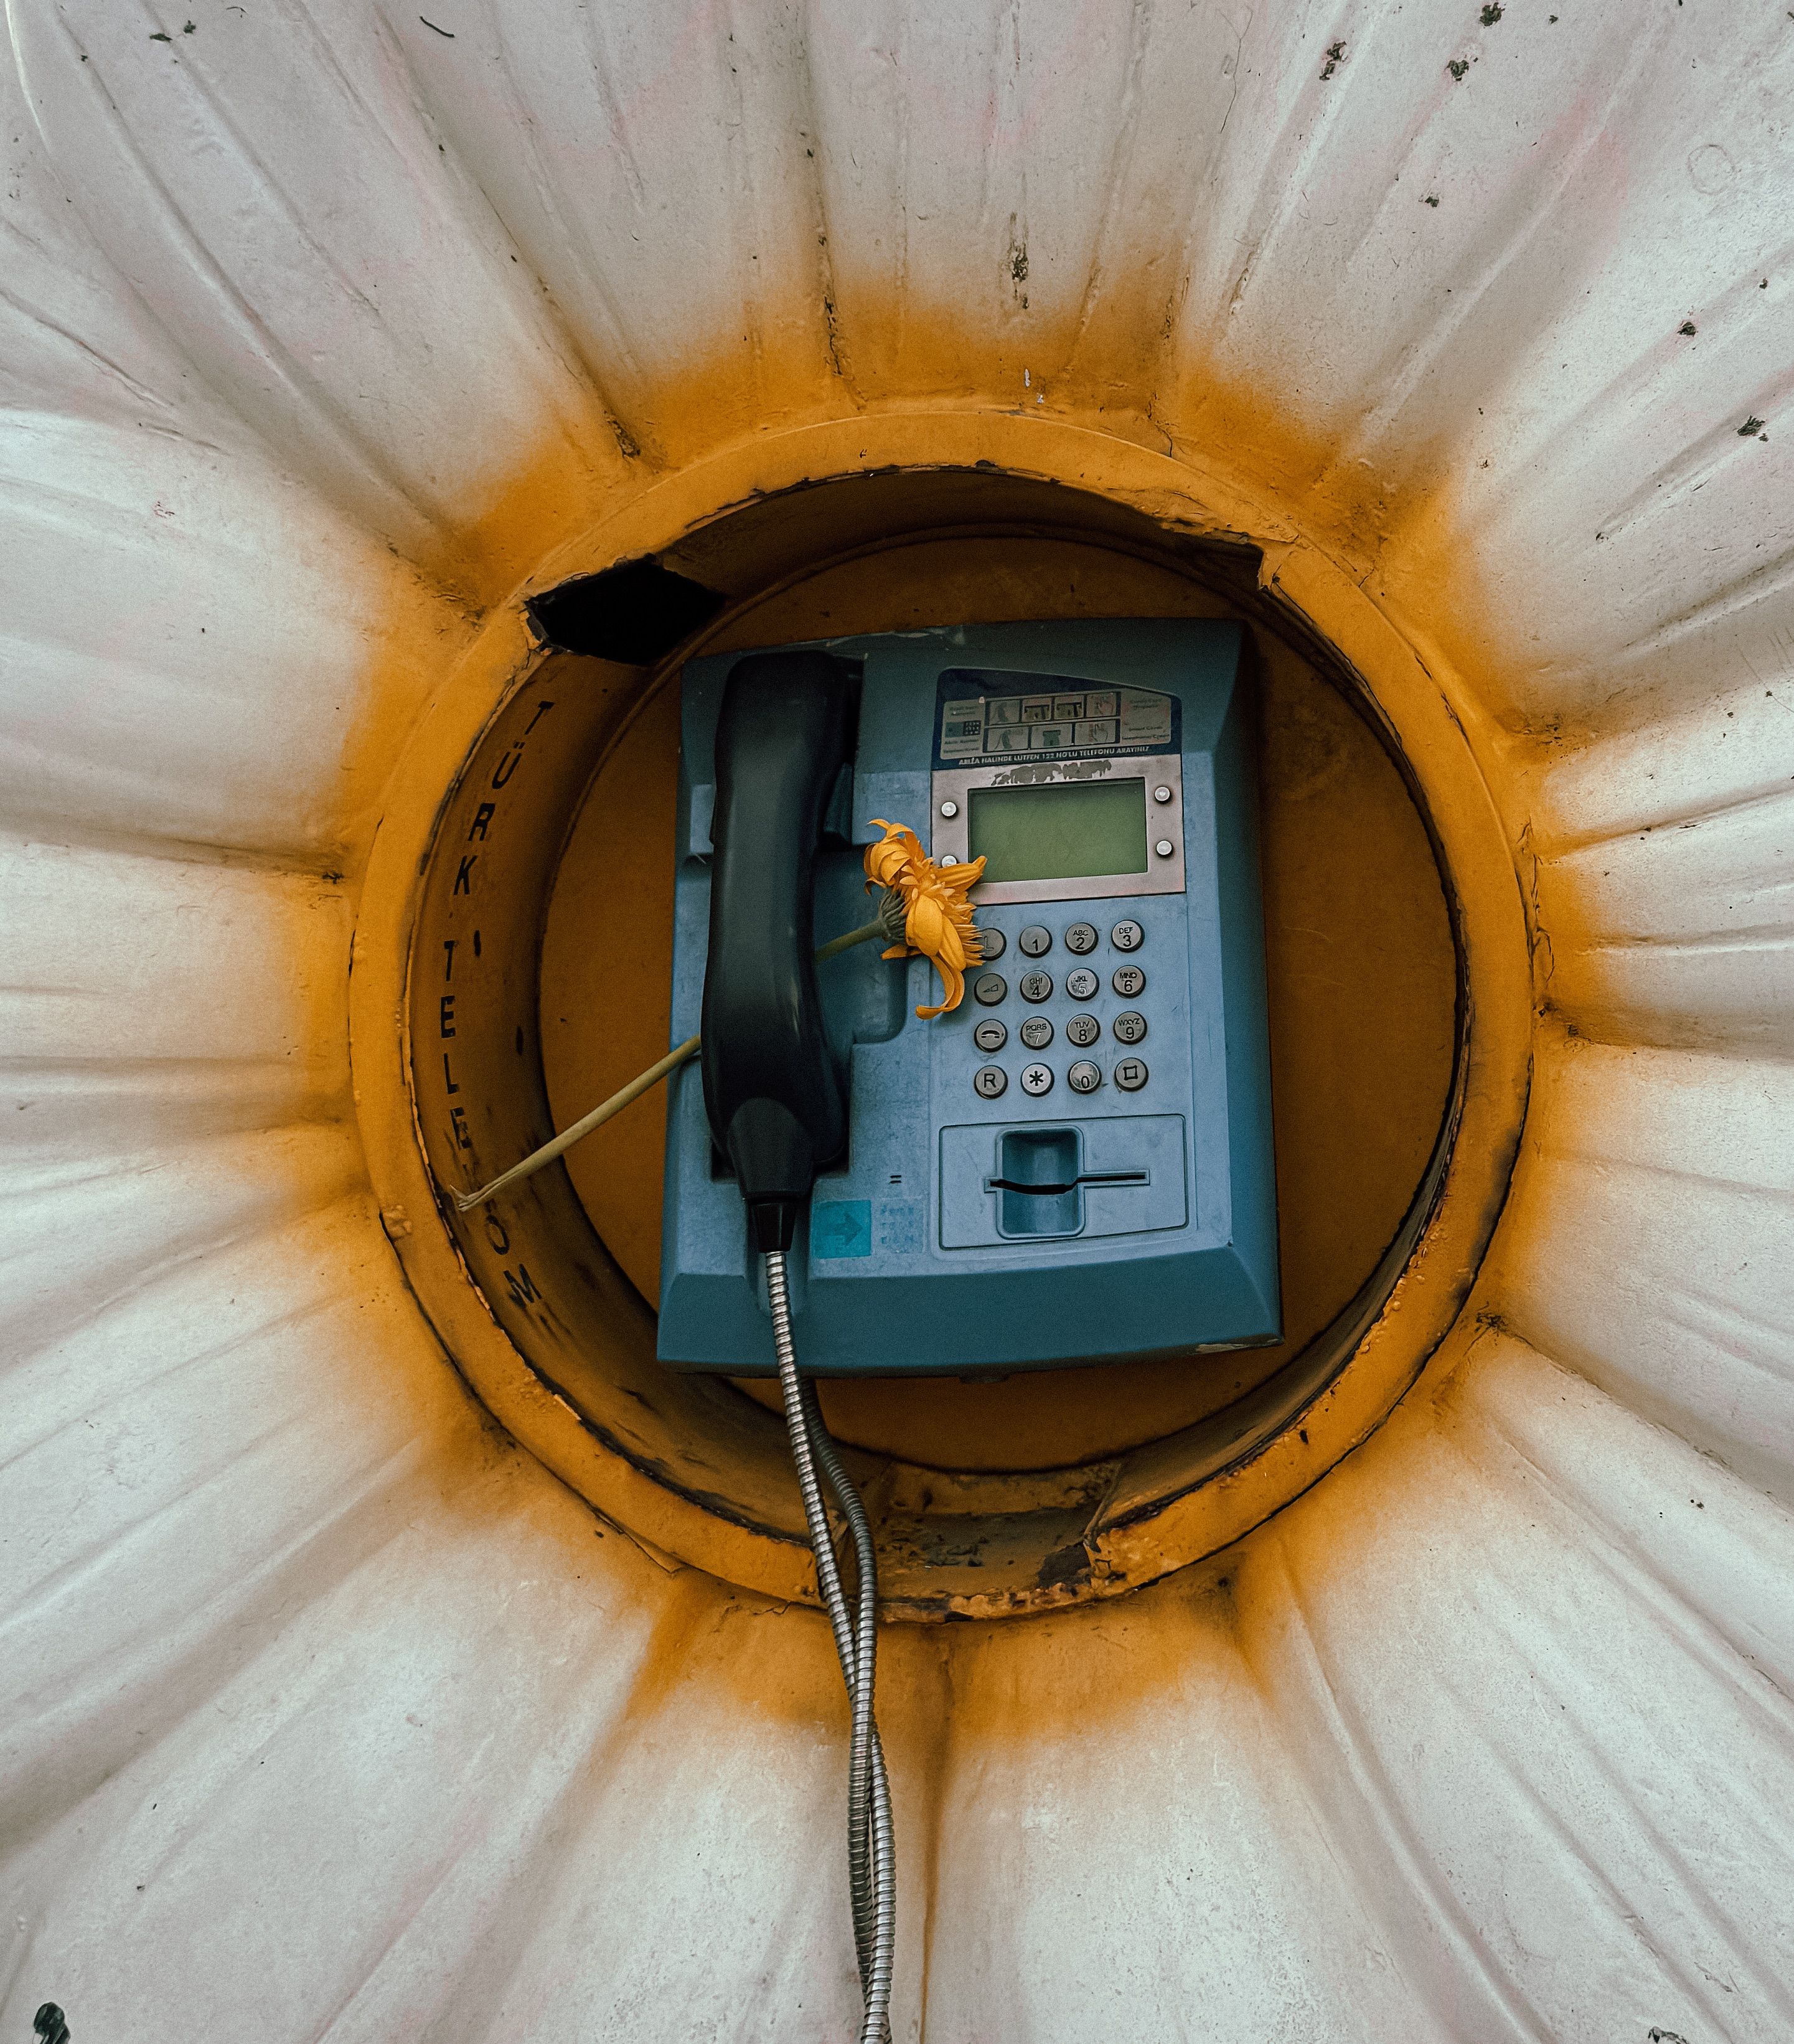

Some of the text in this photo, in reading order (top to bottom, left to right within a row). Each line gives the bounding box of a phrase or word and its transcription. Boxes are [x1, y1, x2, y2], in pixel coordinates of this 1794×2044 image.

[453, 701, 555, 895] TÜRK
[1032, 939, 1038, 951] 1
[1076, 937, 1084, 949] 2
[1123, 935, 1132, 947] 3
[1031, 985, 1041, 997] 4
[1079, 982, 1087, 995] 5
[1124, 979, 1132, 992] 6
[1117, 1018, 1140, 1026] WXYZ
[1034, 1032, 1041, 1045] 7
[1079, 1029, 1087, 1042] 8
[1126, 1027, 1134, 1039] 9
[984, 1073, 996, 1088] R
[1081, 1076, 1089, 1088] 0
